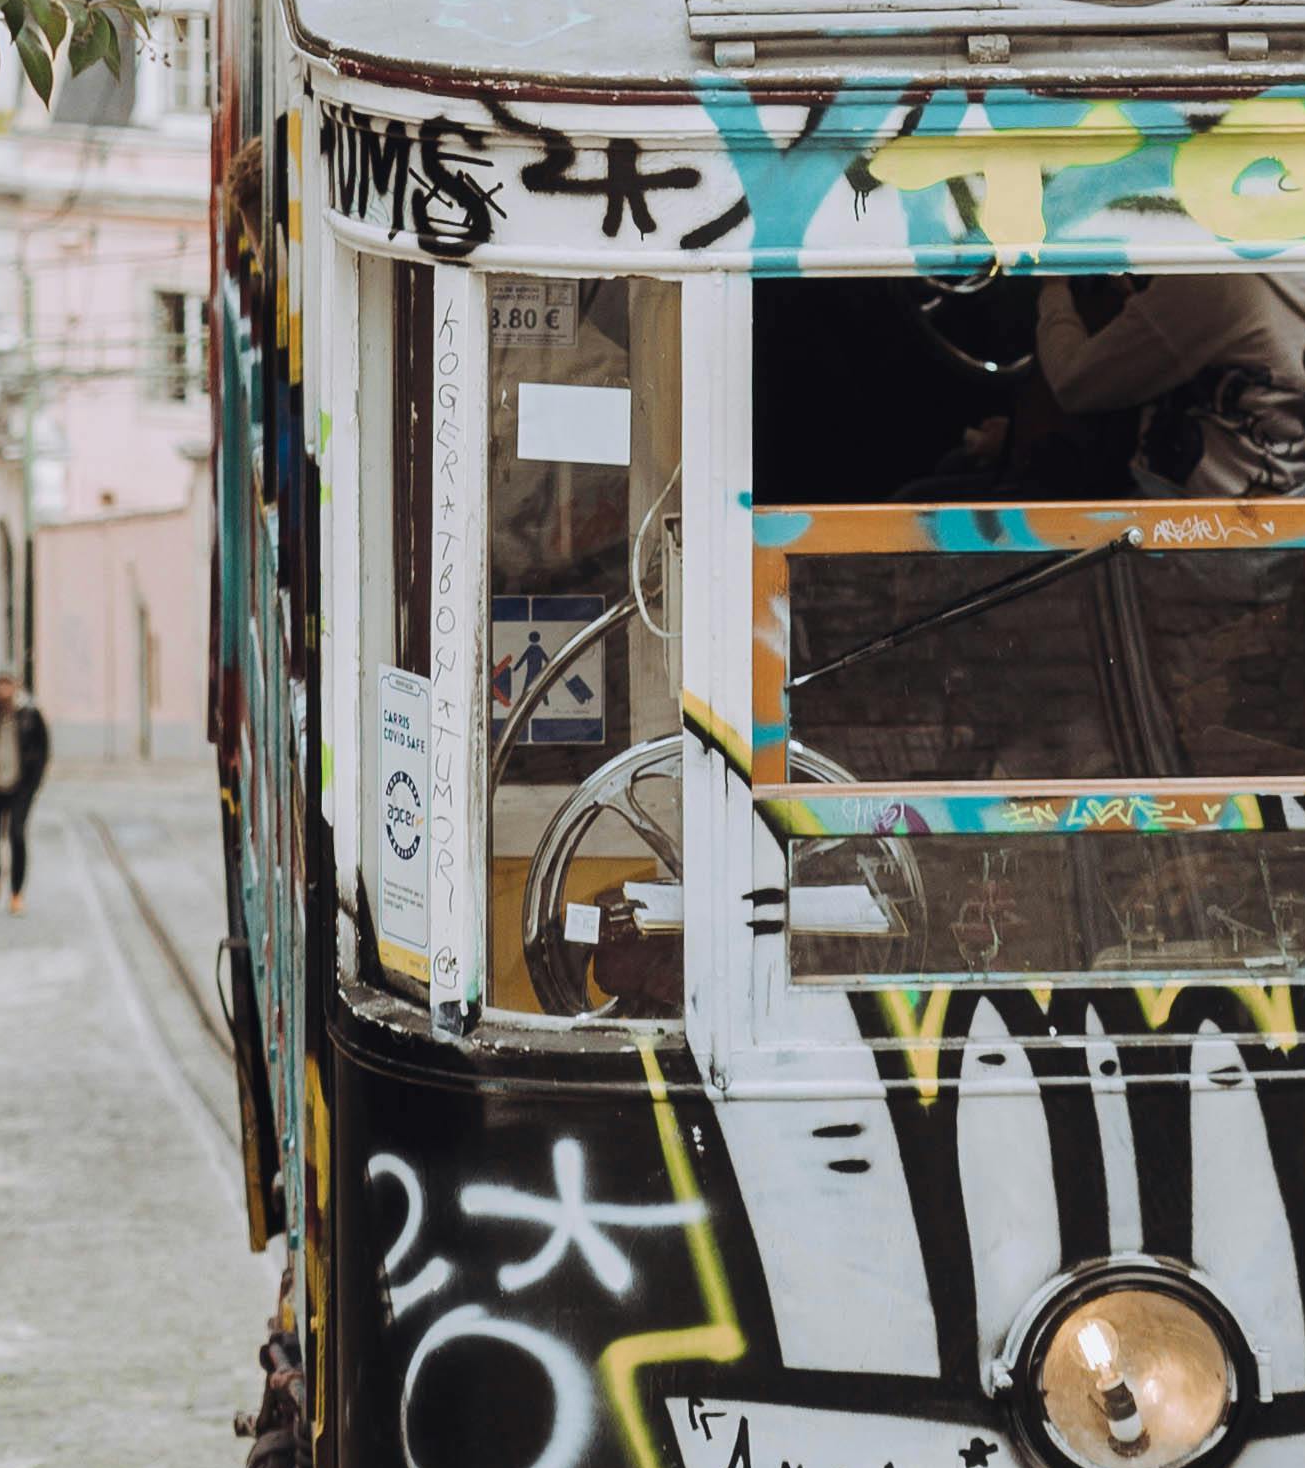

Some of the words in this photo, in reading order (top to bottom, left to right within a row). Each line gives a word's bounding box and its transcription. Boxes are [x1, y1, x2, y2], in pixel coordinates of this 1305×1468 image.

[383, 709, 411, 730] CARRIS
[383, 726, 406, 746] COVID
[406, 735, 426, 755] SAFE
